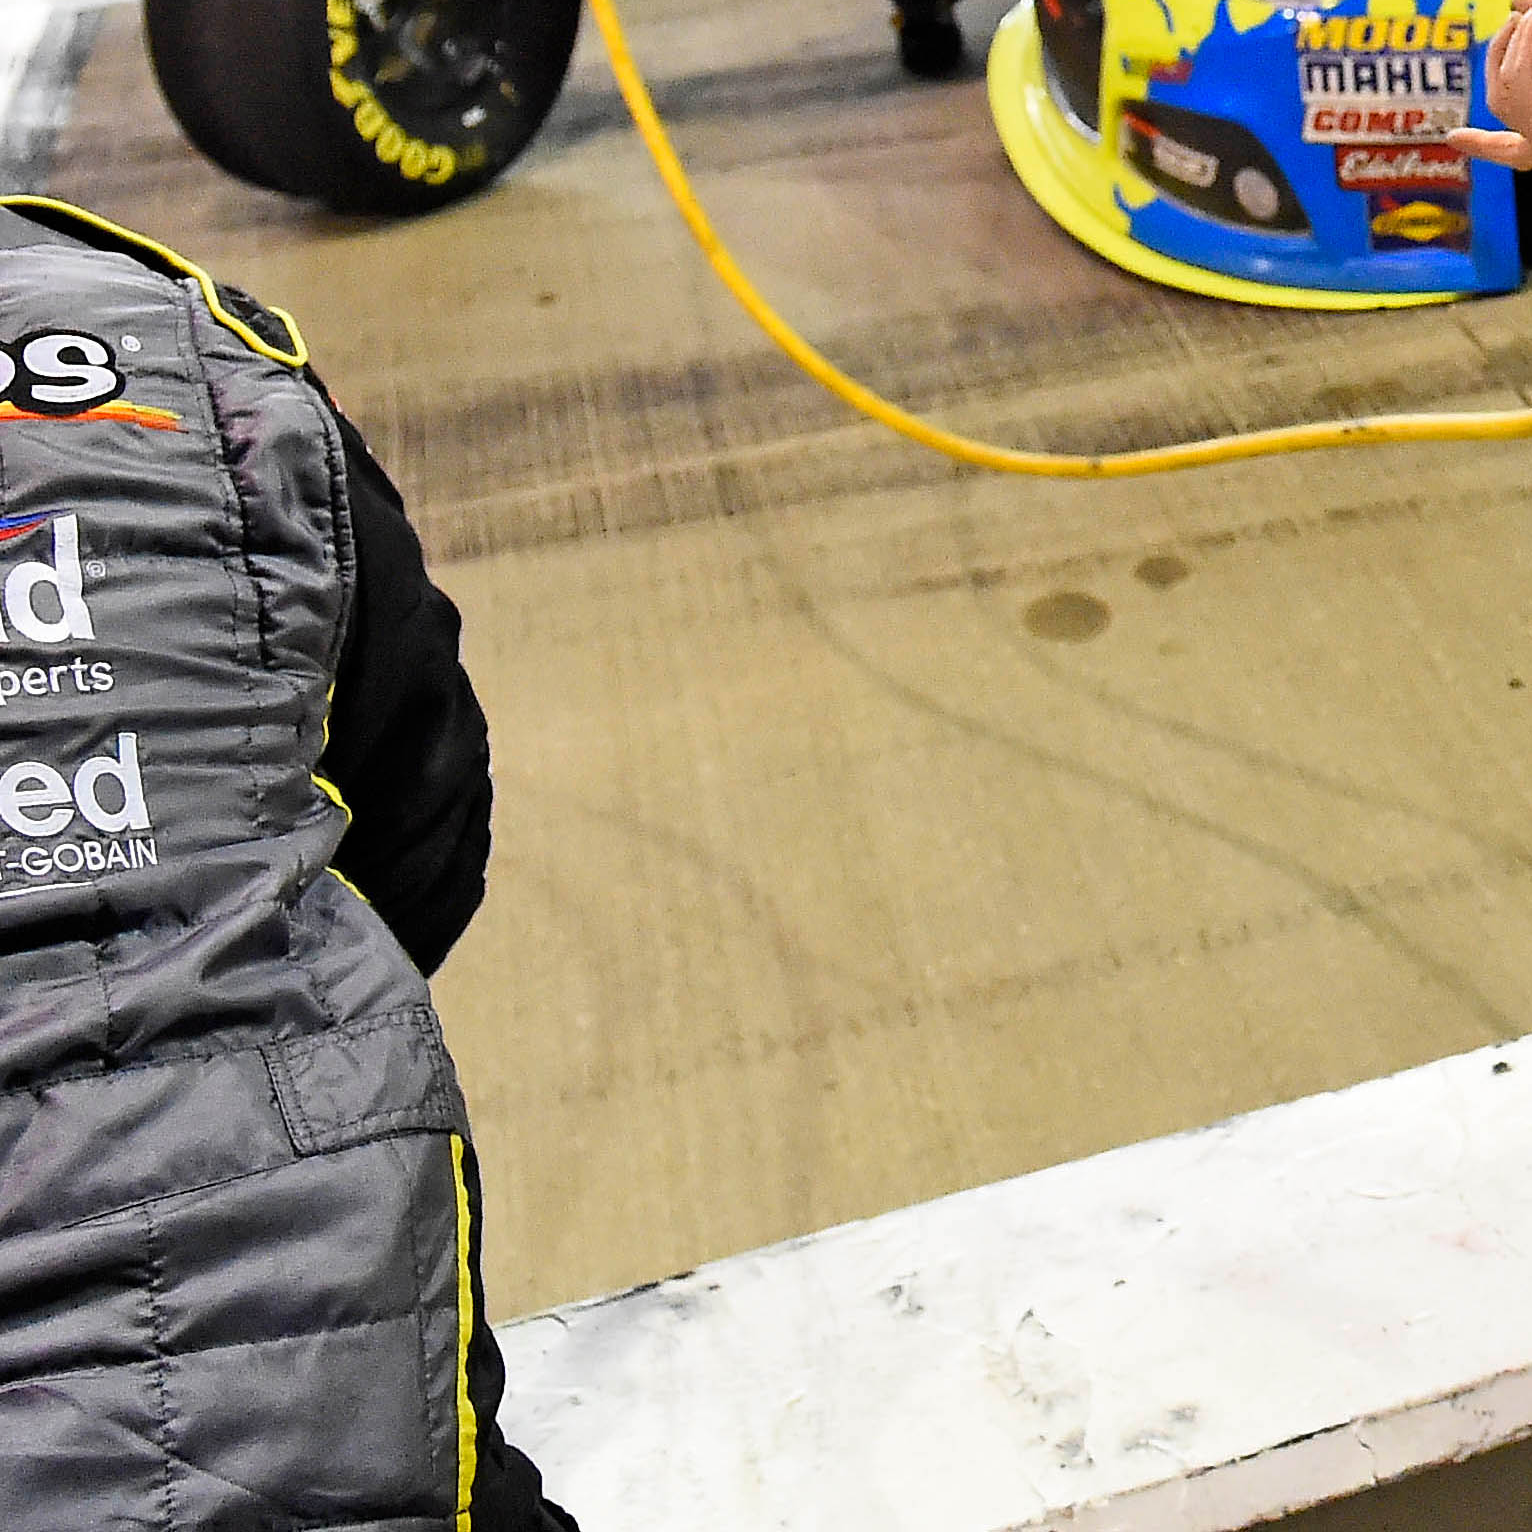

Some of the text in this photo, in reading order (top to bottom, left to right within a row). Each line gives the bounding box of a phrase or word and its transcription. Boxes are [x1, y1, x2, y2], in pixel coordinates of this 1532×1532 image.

[1297, 16, 1469, 52] MOOG
[1305, 59, 1466, 93] MAHLE
[1313, 109, 1426, 133] COMP
